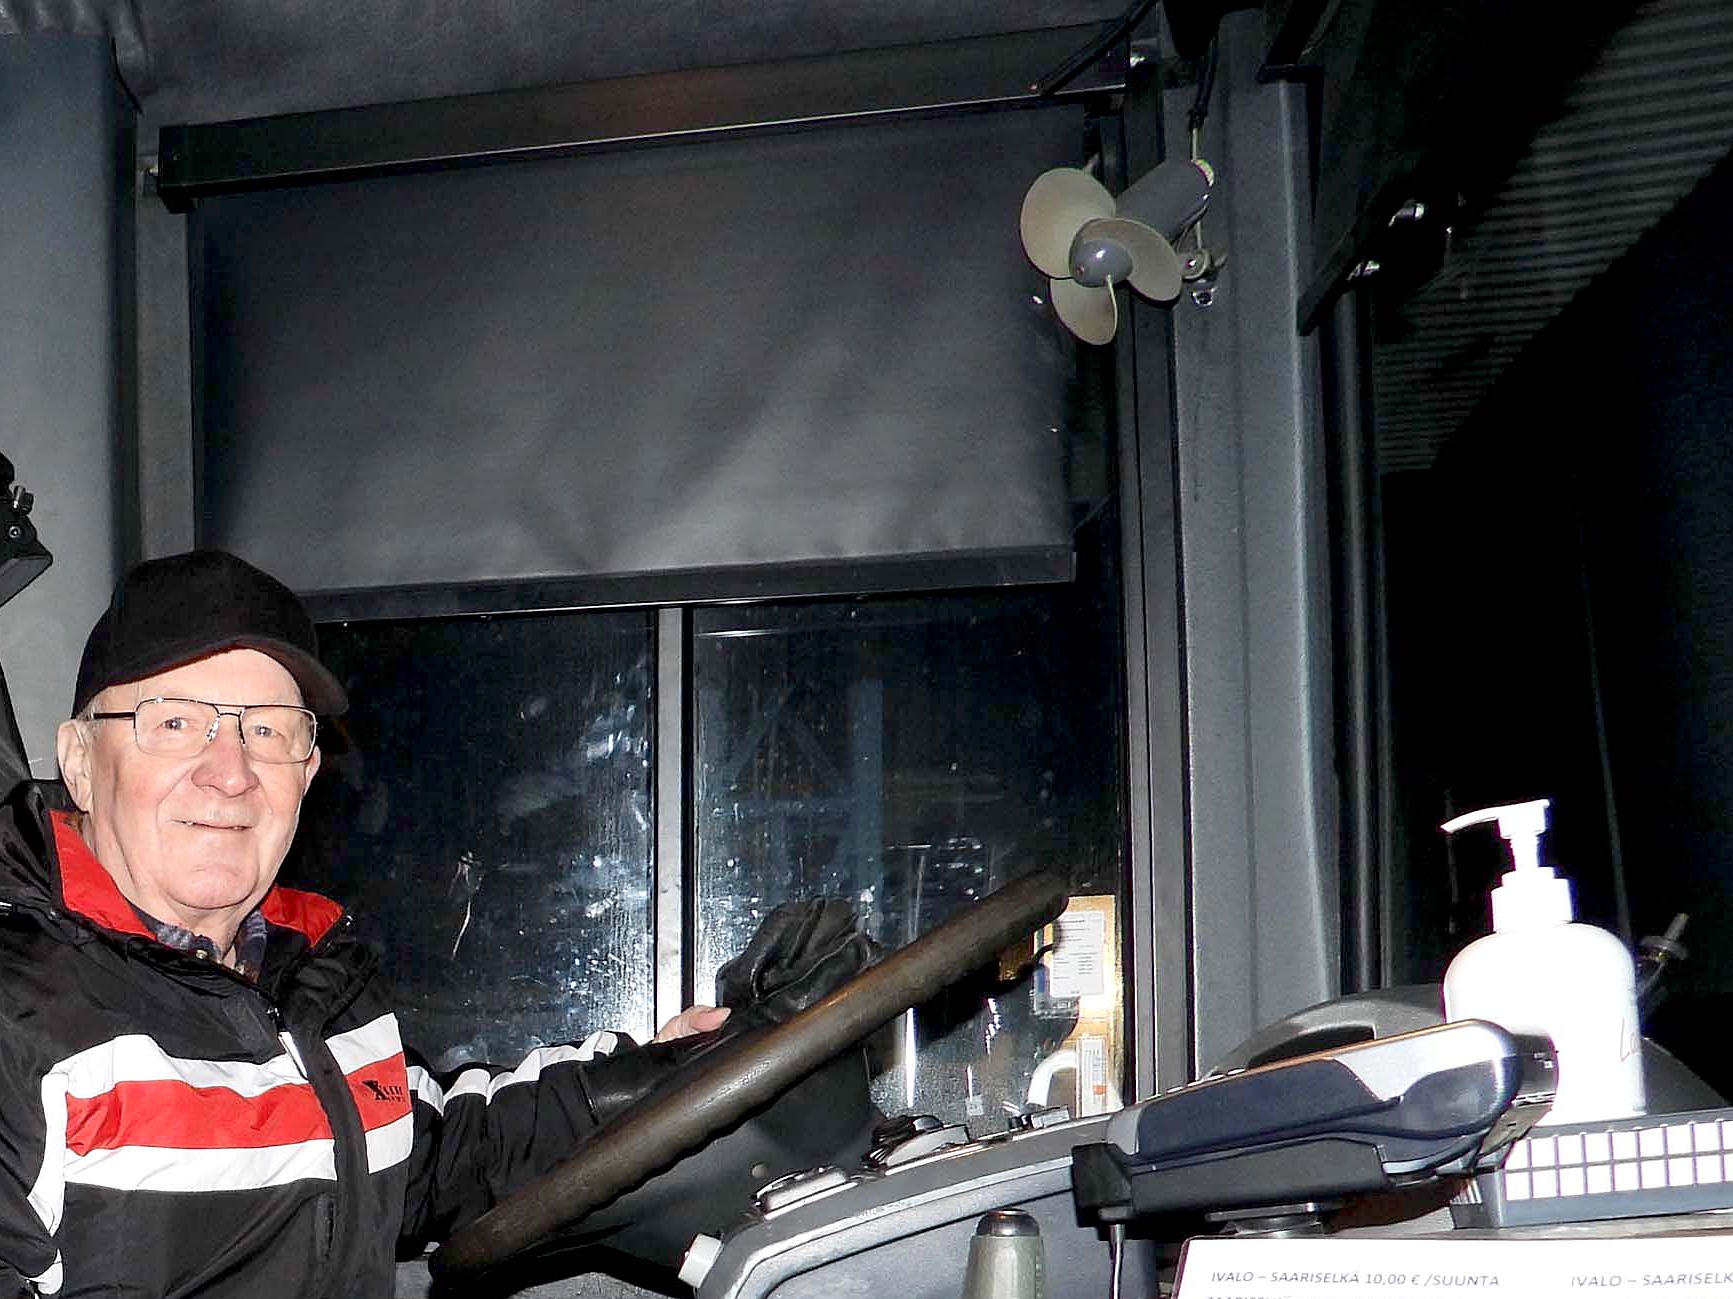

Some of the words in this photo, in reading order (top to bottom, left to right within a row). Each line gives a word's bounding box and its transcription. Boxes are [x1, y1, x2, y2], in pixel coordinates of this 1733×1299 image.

[1211, 1271, 1253, 1282] IVALO
[1270, 1271, 1359, 1284] SAARISELKÄ
[1366, 1273, 1406, 1286] 10,00
[1411, 1275, 1420, 1285] €
[1424, 1274, 1500, 1287] /SUUNTA
[1571, 1275, 1622, 1287] IVALO
[1643, 1273, 1733, 1286] SAARISELK
